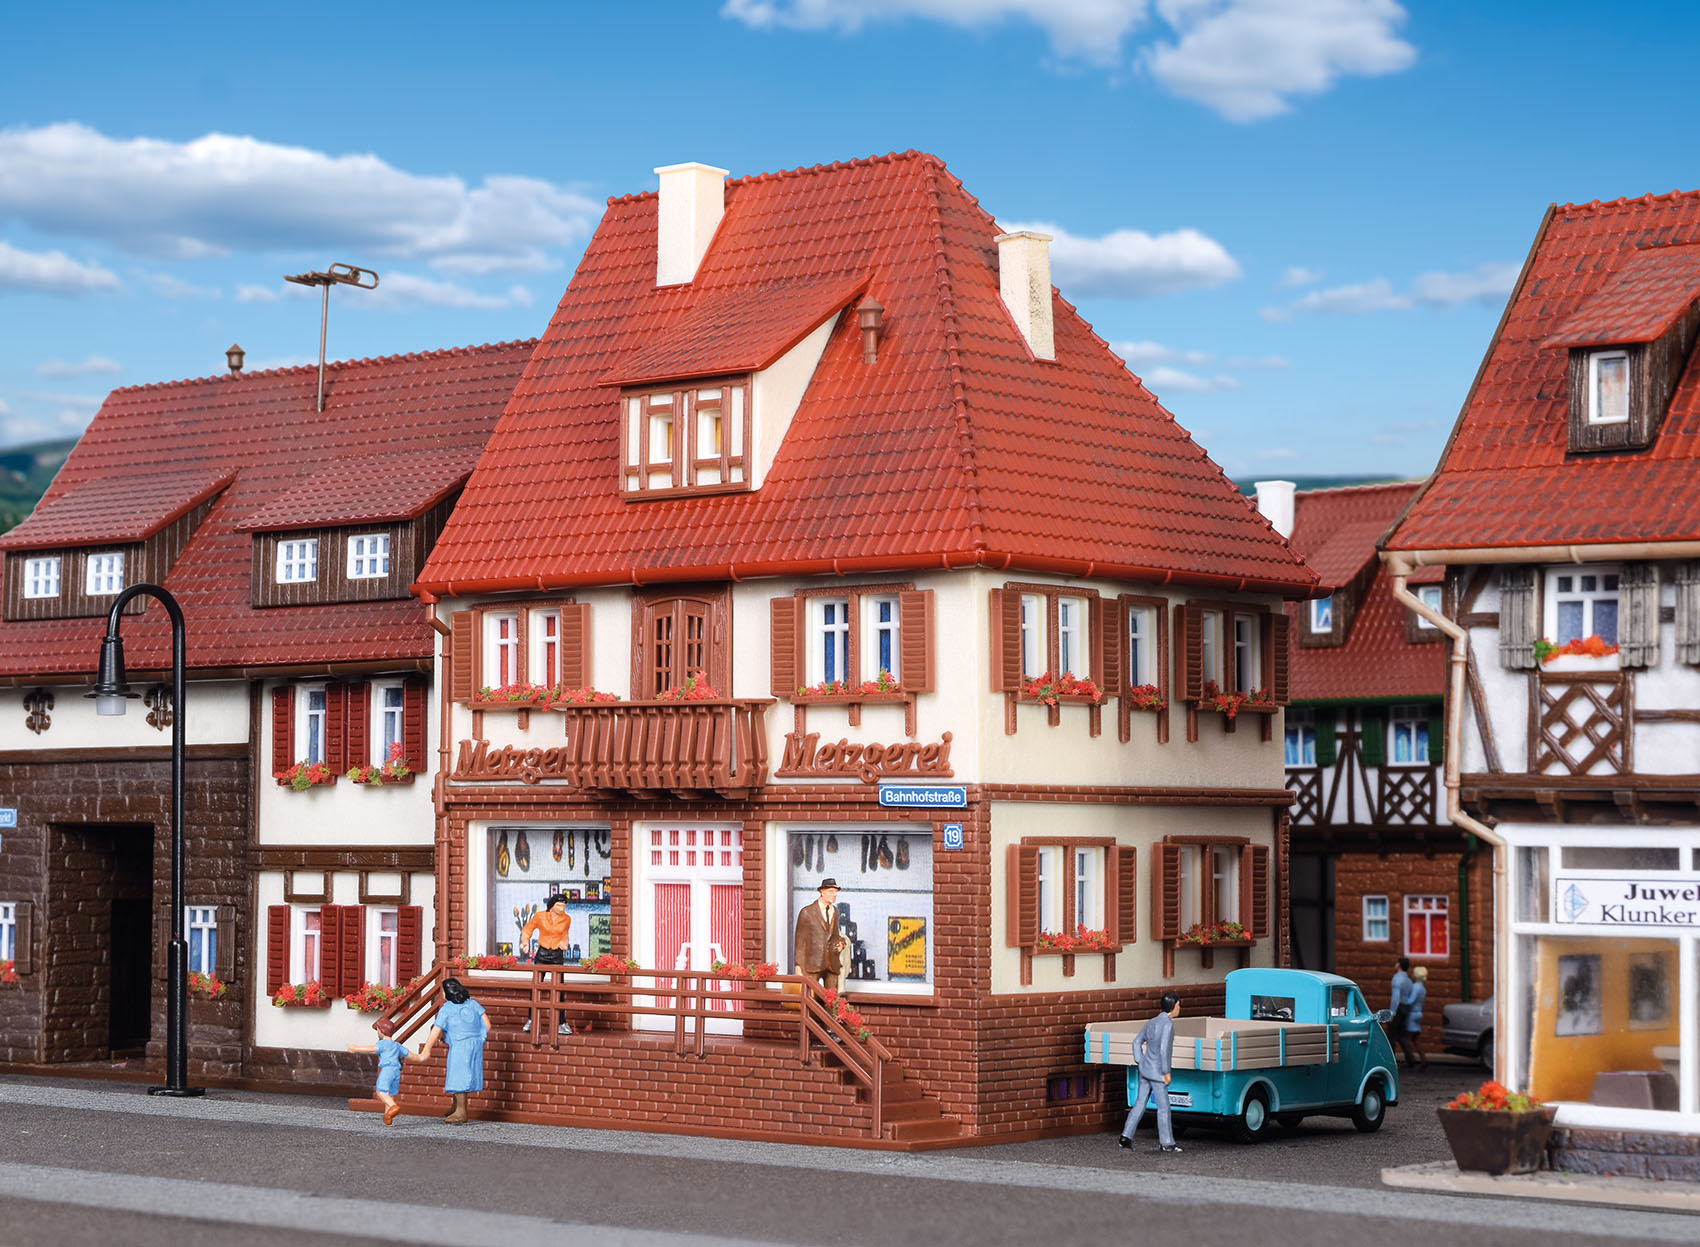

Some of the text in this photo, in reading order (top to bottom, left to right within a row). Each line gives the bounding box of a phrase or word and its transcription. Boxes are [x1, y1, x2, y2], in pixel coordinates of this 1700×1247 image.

[452, 739, 568, 784] Metzger
[775, 731, 954, 784] Metzgerei
[885, 790, 961, 803] Bahnhofstraße
[947, 830, 959, 842] 19
[1601, 904, 1697, 924] Klunker
